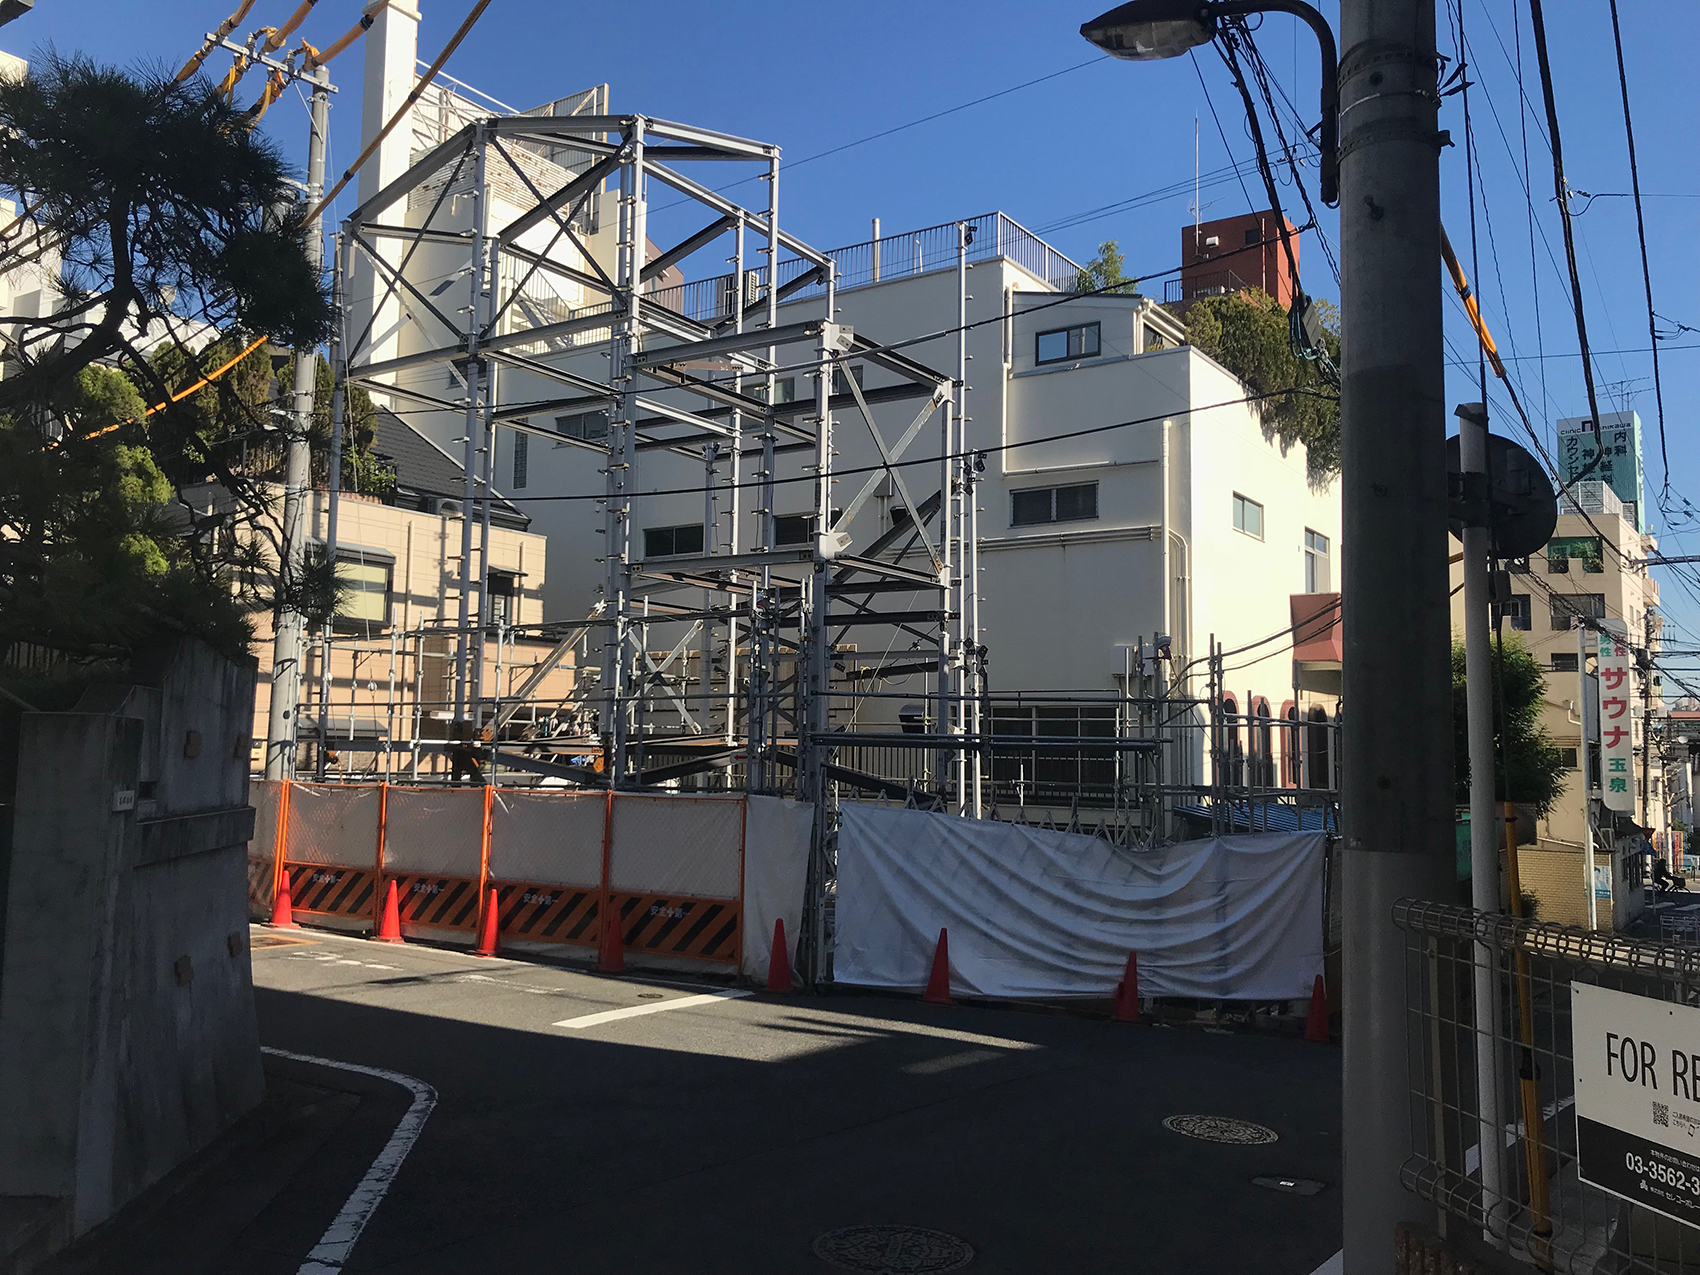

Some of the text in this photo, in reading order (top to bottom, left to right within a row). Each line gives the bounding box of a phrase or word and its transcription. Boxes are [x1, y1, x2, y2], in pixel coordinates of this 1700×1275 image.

[1614, 430, 1627, 456] 内科
[1600, 667, 1629, 793] サウナ 玉泉
[1606, 1032, 1658, 1090] FOR
[1626, 1152, 1700, 1196] 03-3562-3
